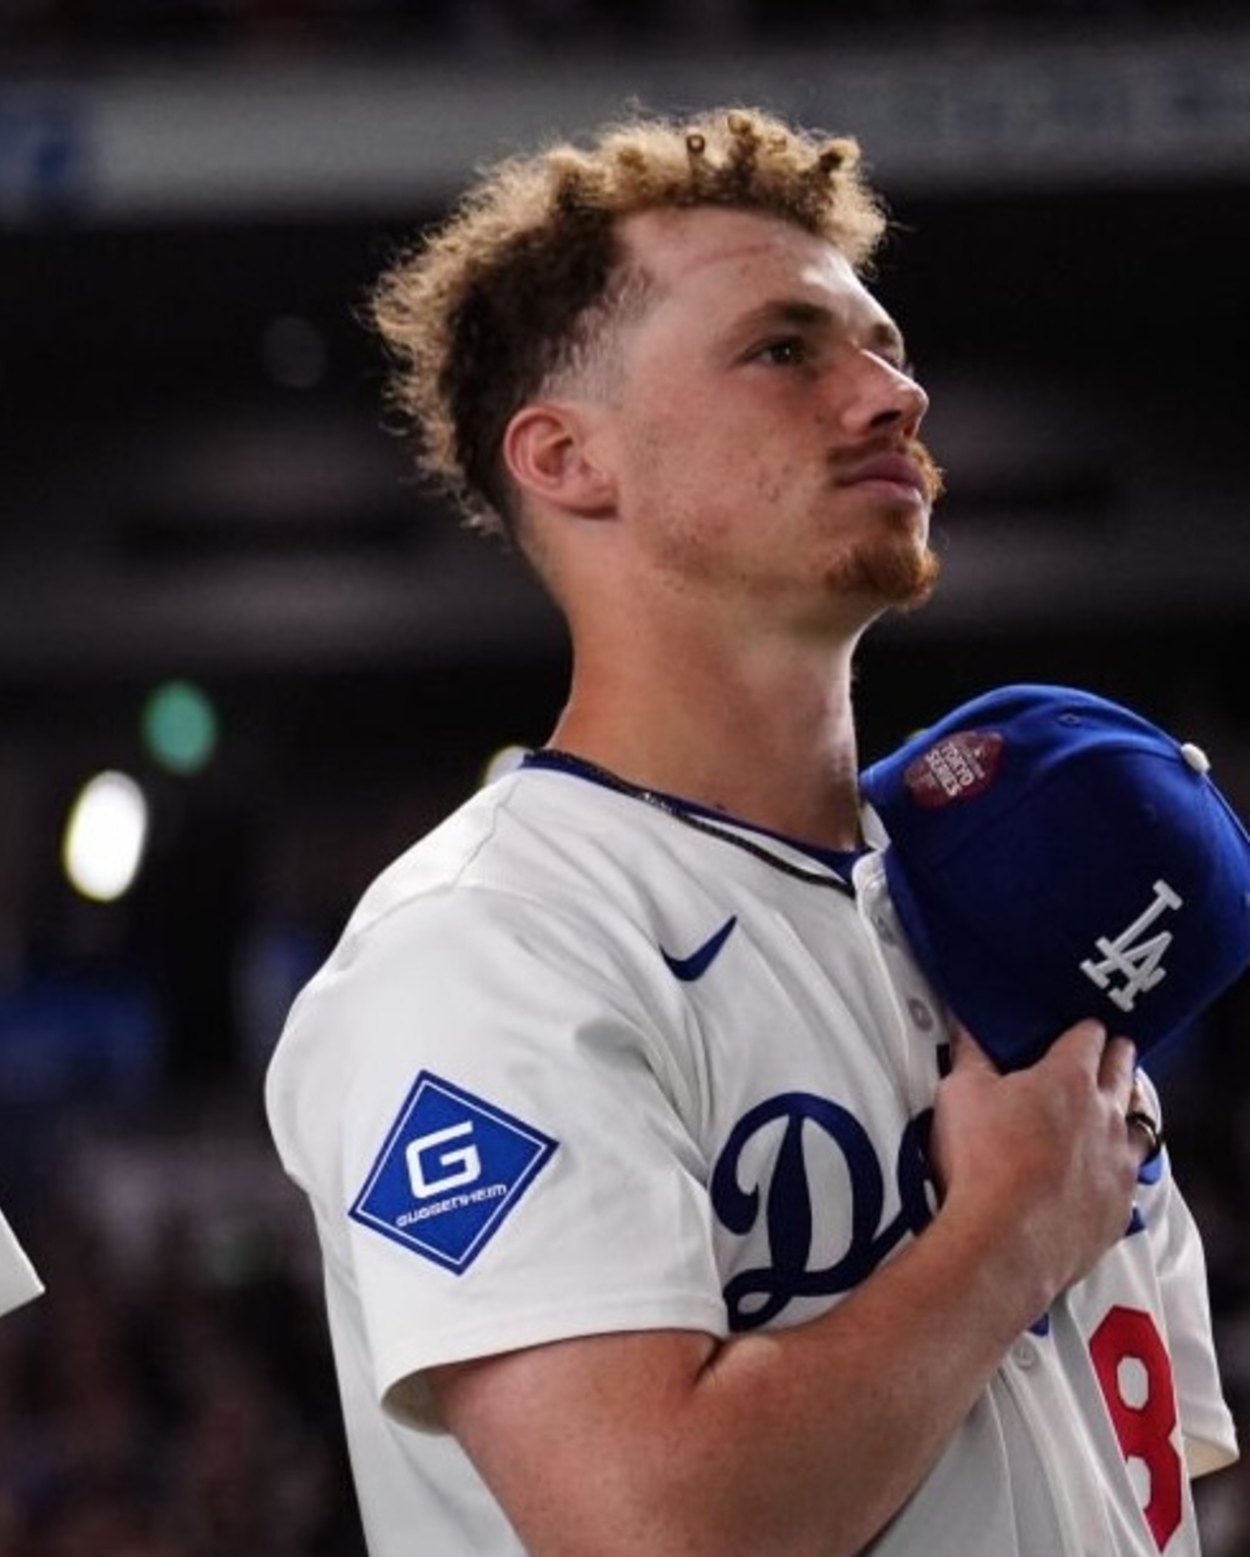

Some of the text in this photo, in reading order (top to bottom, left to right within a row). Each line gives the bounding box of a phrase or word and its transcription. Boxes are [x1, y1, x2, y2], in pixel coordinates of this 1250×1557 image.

[1080, 879, 1183, 1012] LA
[405, 1120, 481, 1199] G
[396, 1183, 508, 1228] GUGGENHEIM
